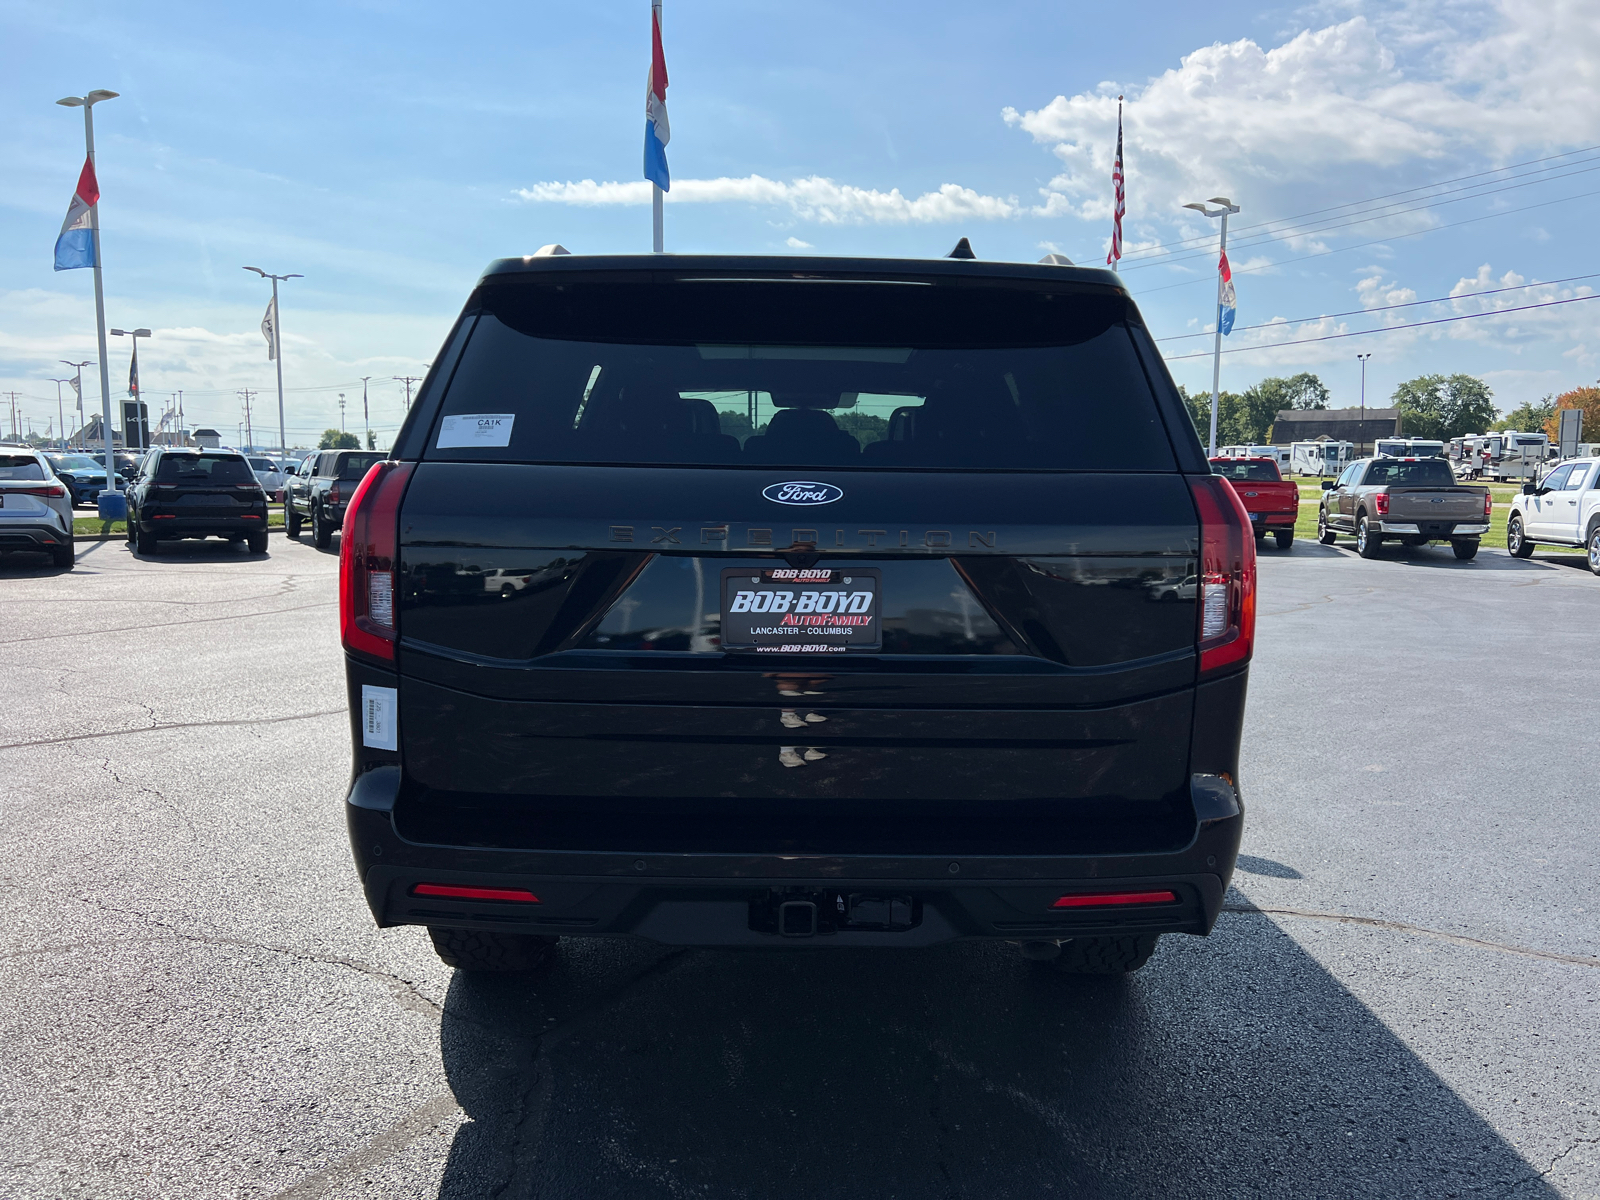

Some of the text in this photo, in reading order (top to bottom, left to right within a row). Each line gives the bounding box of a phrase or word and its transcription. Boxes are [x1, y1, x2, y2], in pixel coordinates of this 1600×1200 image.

[778, 483, 827, 501] Ford
[609, 525, 996, 548] EXPEDITION
[730, 591, 873, 612] BOB-BOYD
[750, 627, 799, 635] LANCASTER
[807, 627, 853, 635] COLUMBUS
